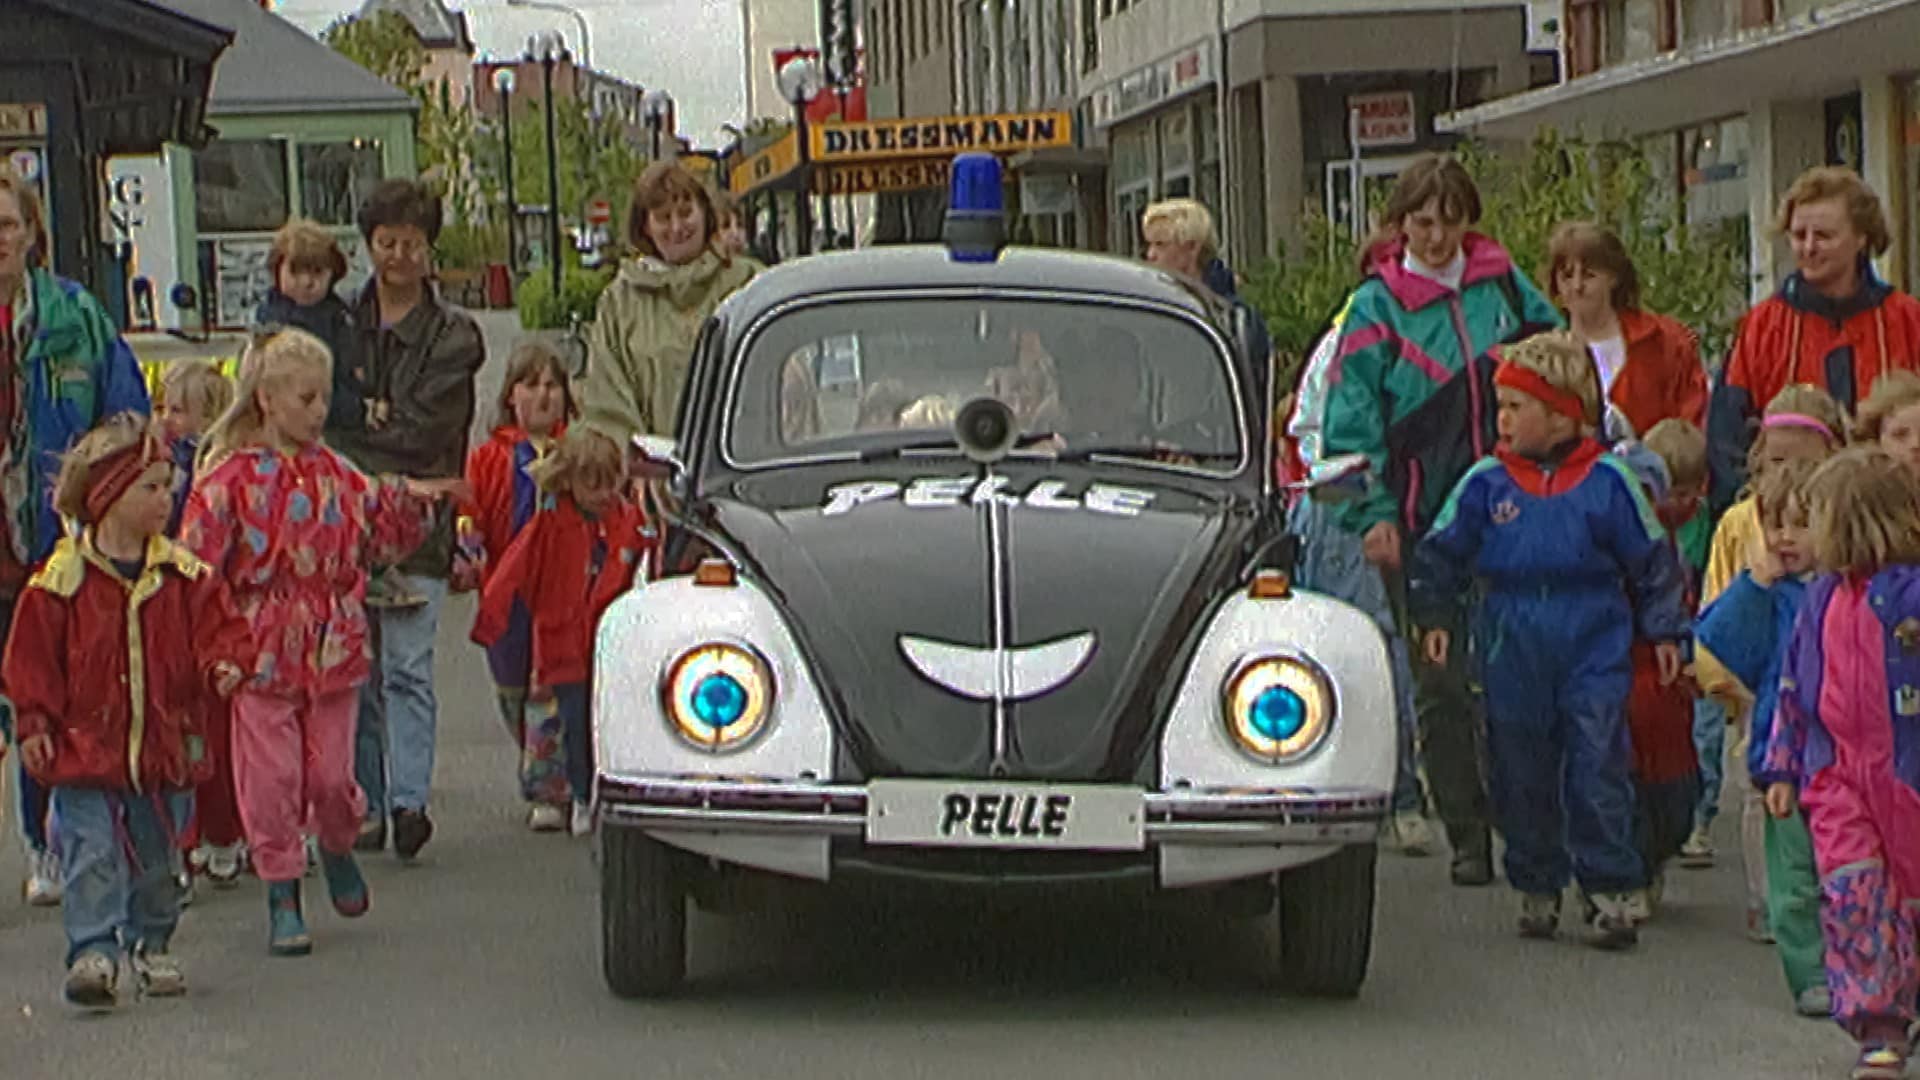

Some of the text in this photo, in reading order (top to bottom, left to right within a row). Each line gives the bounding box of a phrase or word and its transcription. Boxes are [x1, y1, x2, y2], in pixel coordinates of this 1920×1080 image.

[824, 117, 1057, 154] DRESSMANN
[822, 476, 1156, 516] PELLE
[941, 792, 1072, 837] PELLE
